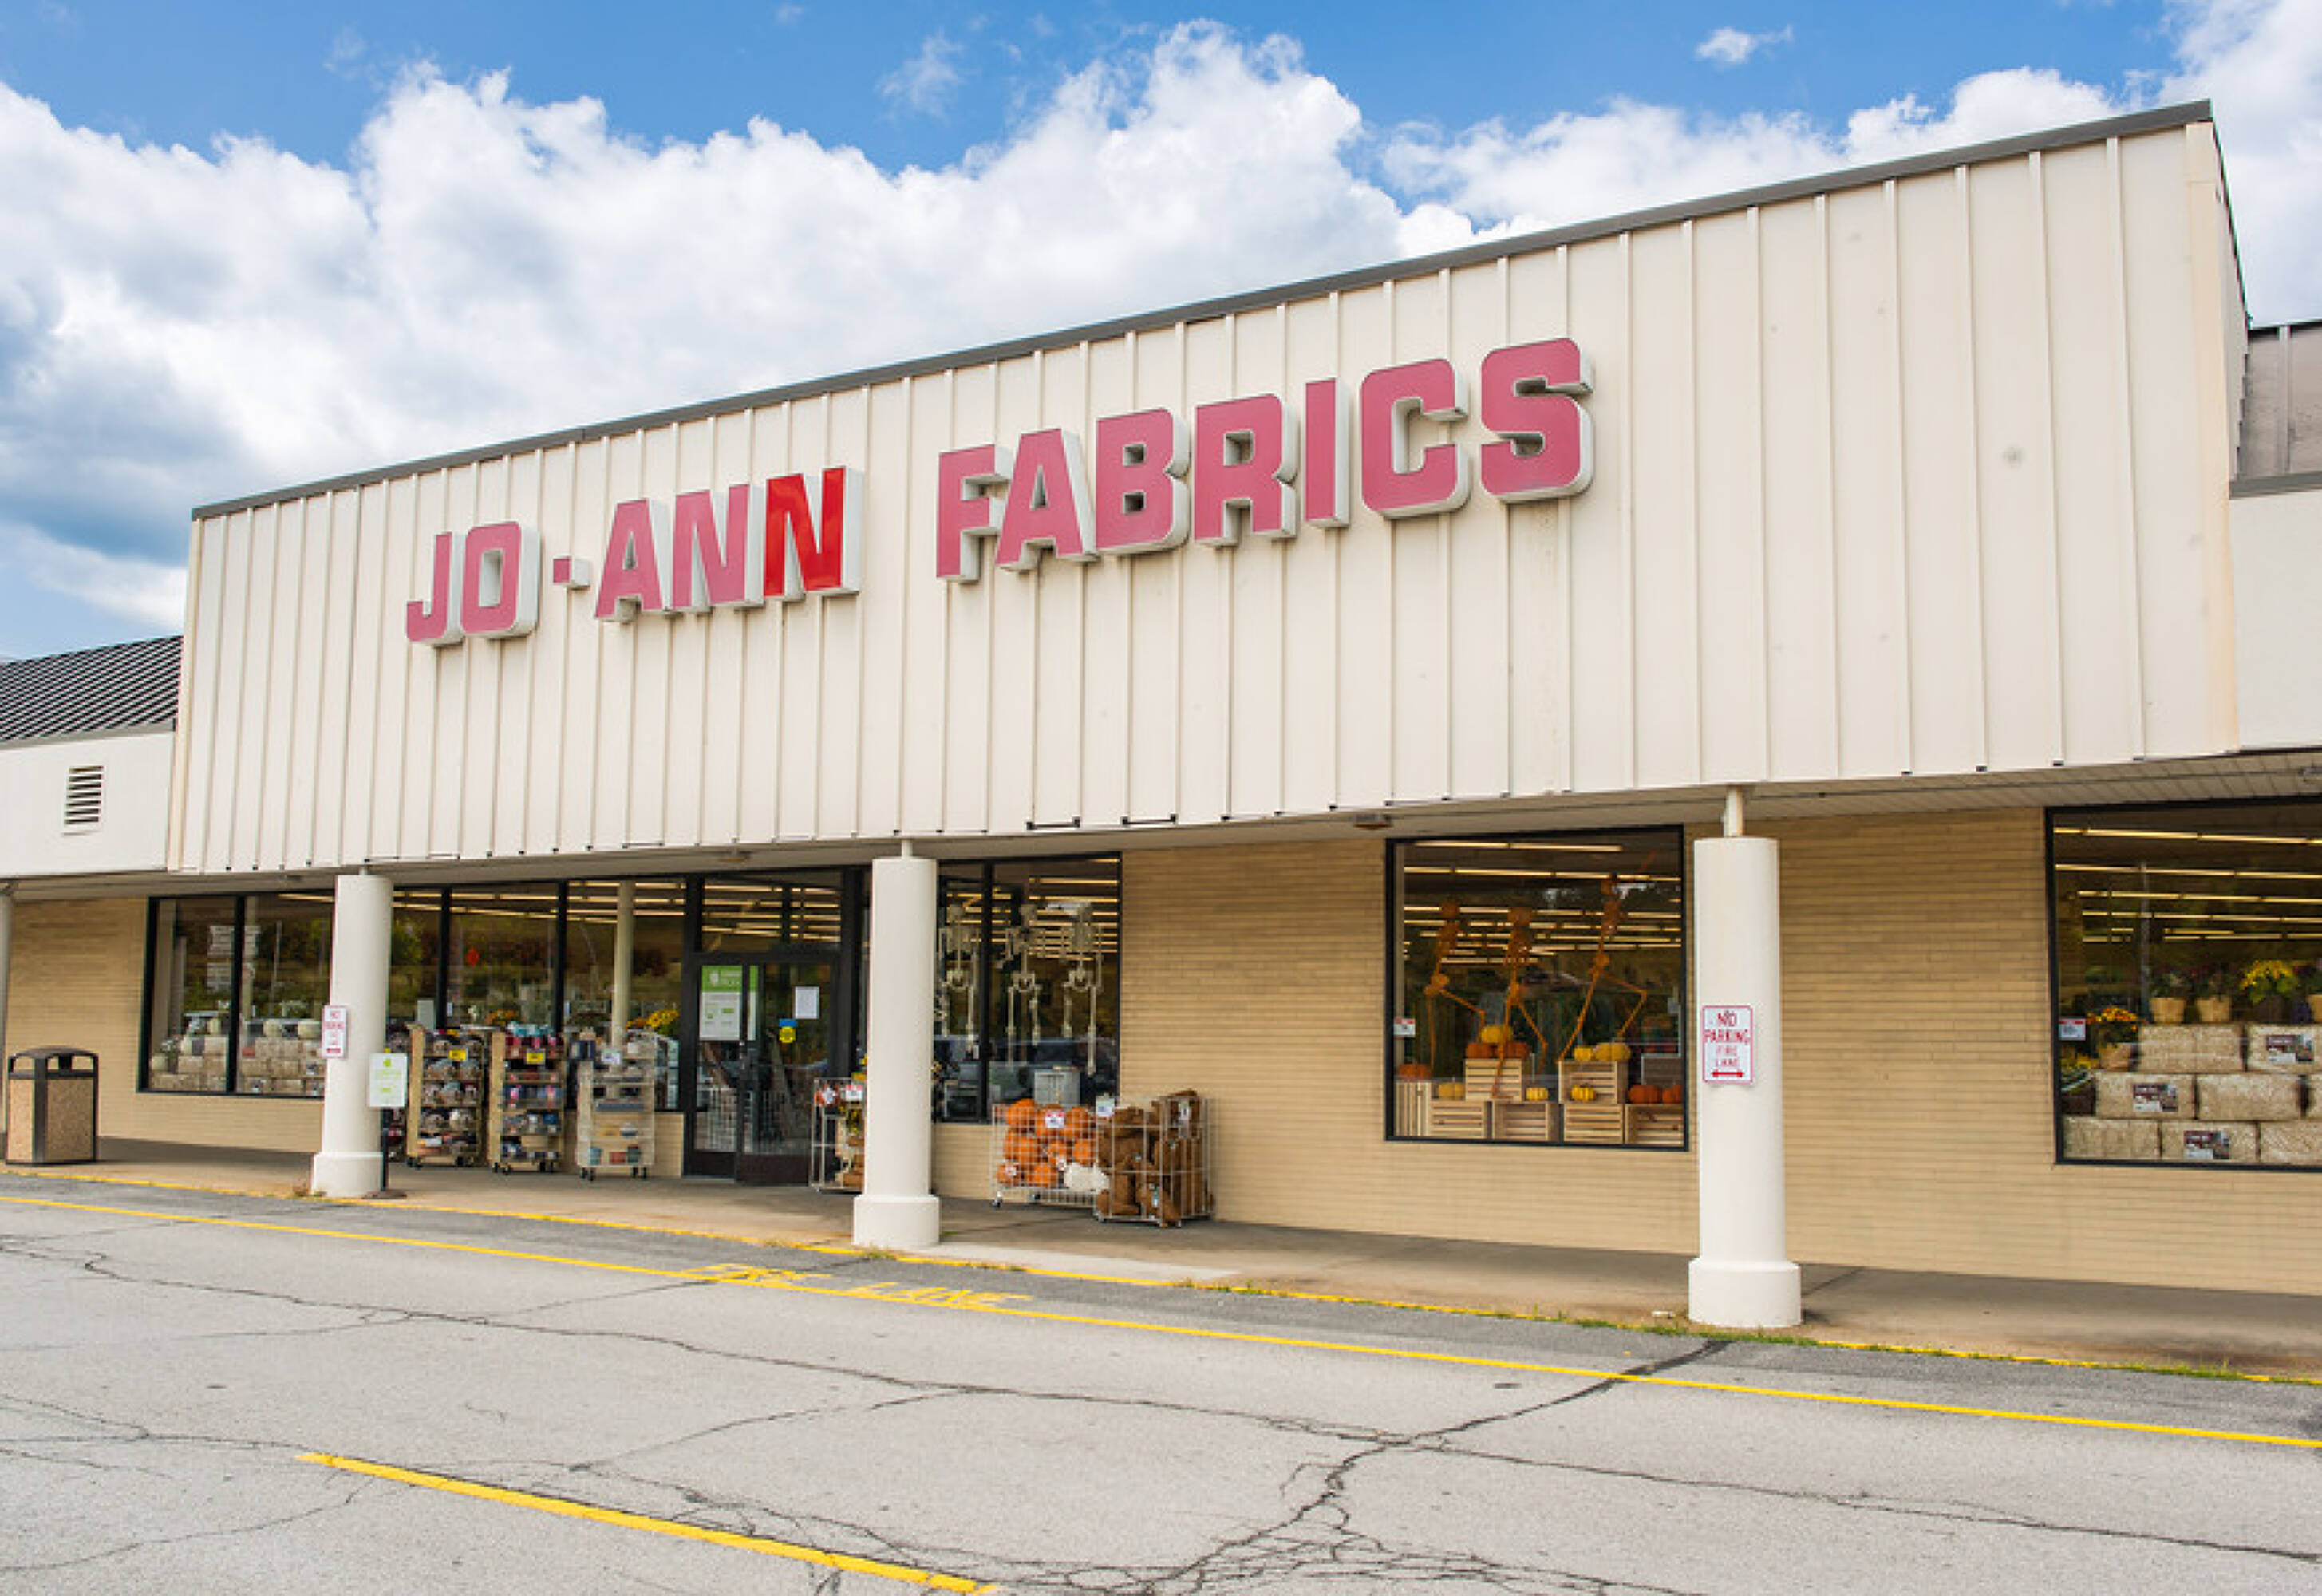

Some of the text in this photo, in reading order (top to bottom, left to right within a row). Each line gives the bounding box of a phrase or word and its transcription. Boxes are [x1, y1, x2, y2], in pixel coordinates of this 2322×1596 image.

[936, 338, 1594, 583] FABRICS
[1717, 1012, 1738, 1028] NO
[1704, 1029, 1751, 1045] PARKING
